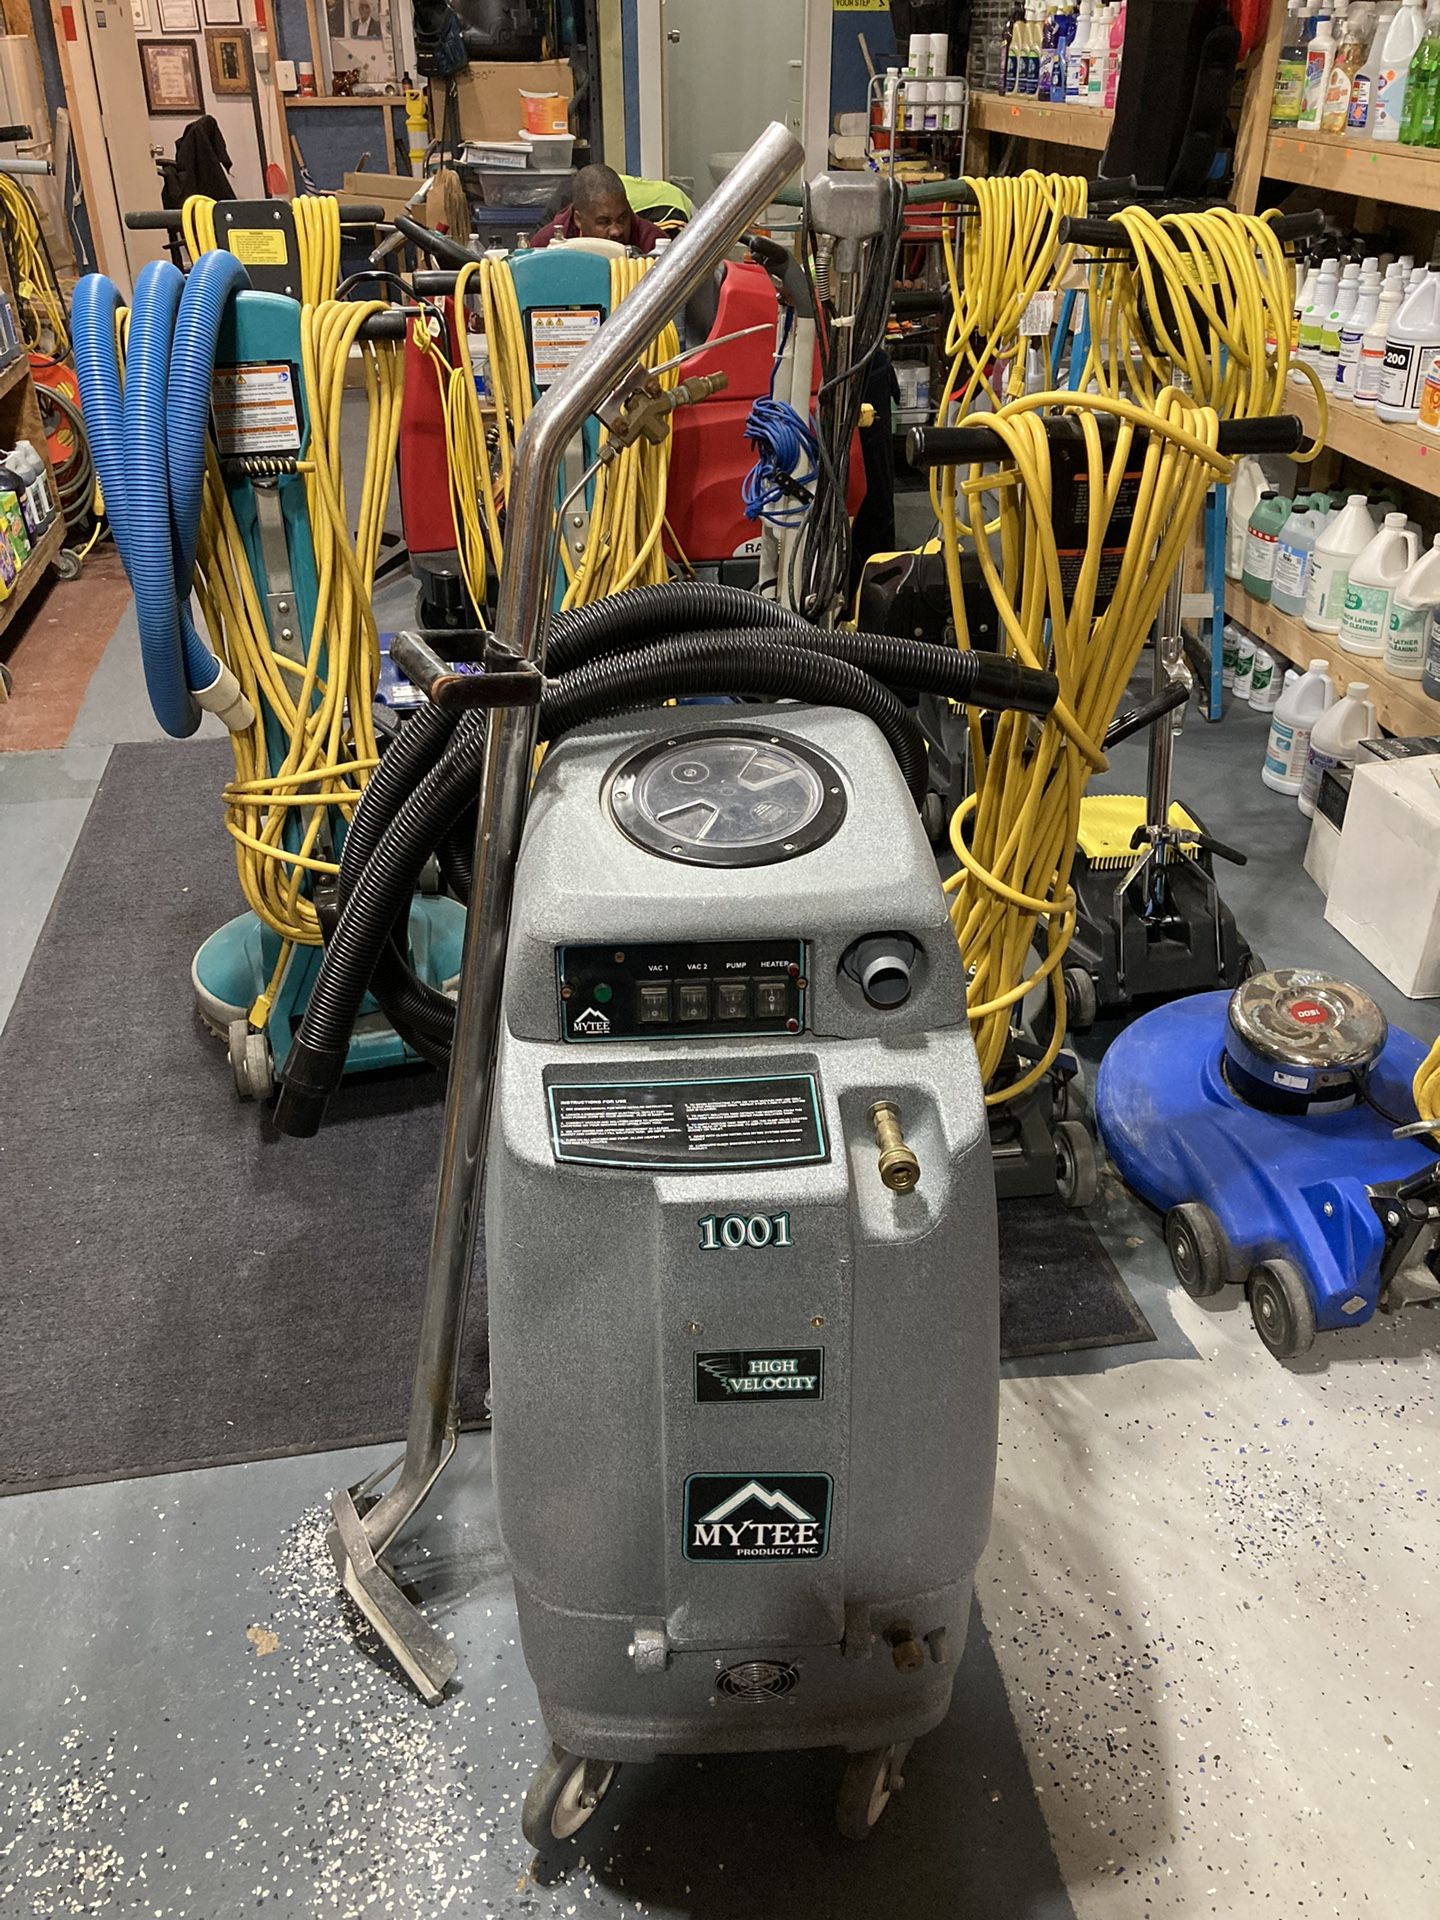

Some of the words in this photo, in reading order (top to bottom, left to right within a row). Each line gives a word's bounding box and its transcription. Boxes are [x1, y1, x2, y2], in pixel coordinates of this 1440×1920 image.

[1349, 622, 1377, 632] CLEANING
[1354, 617, 1378, 626] LATHER
[648, 964, 664, 972] VAC
[760, 960, 790, 968] HEATER
[574, 1020, 610, 1032] MYTEE
[698, 1212, 793, 1249] 1001
[750, 1360, 797, 1374] HIGH
[730, 1376, 816, 1392] VELOCITY
[692, 1519, 820, 1546] MYTEE
[797, 1547, 818, 1555] INC.
